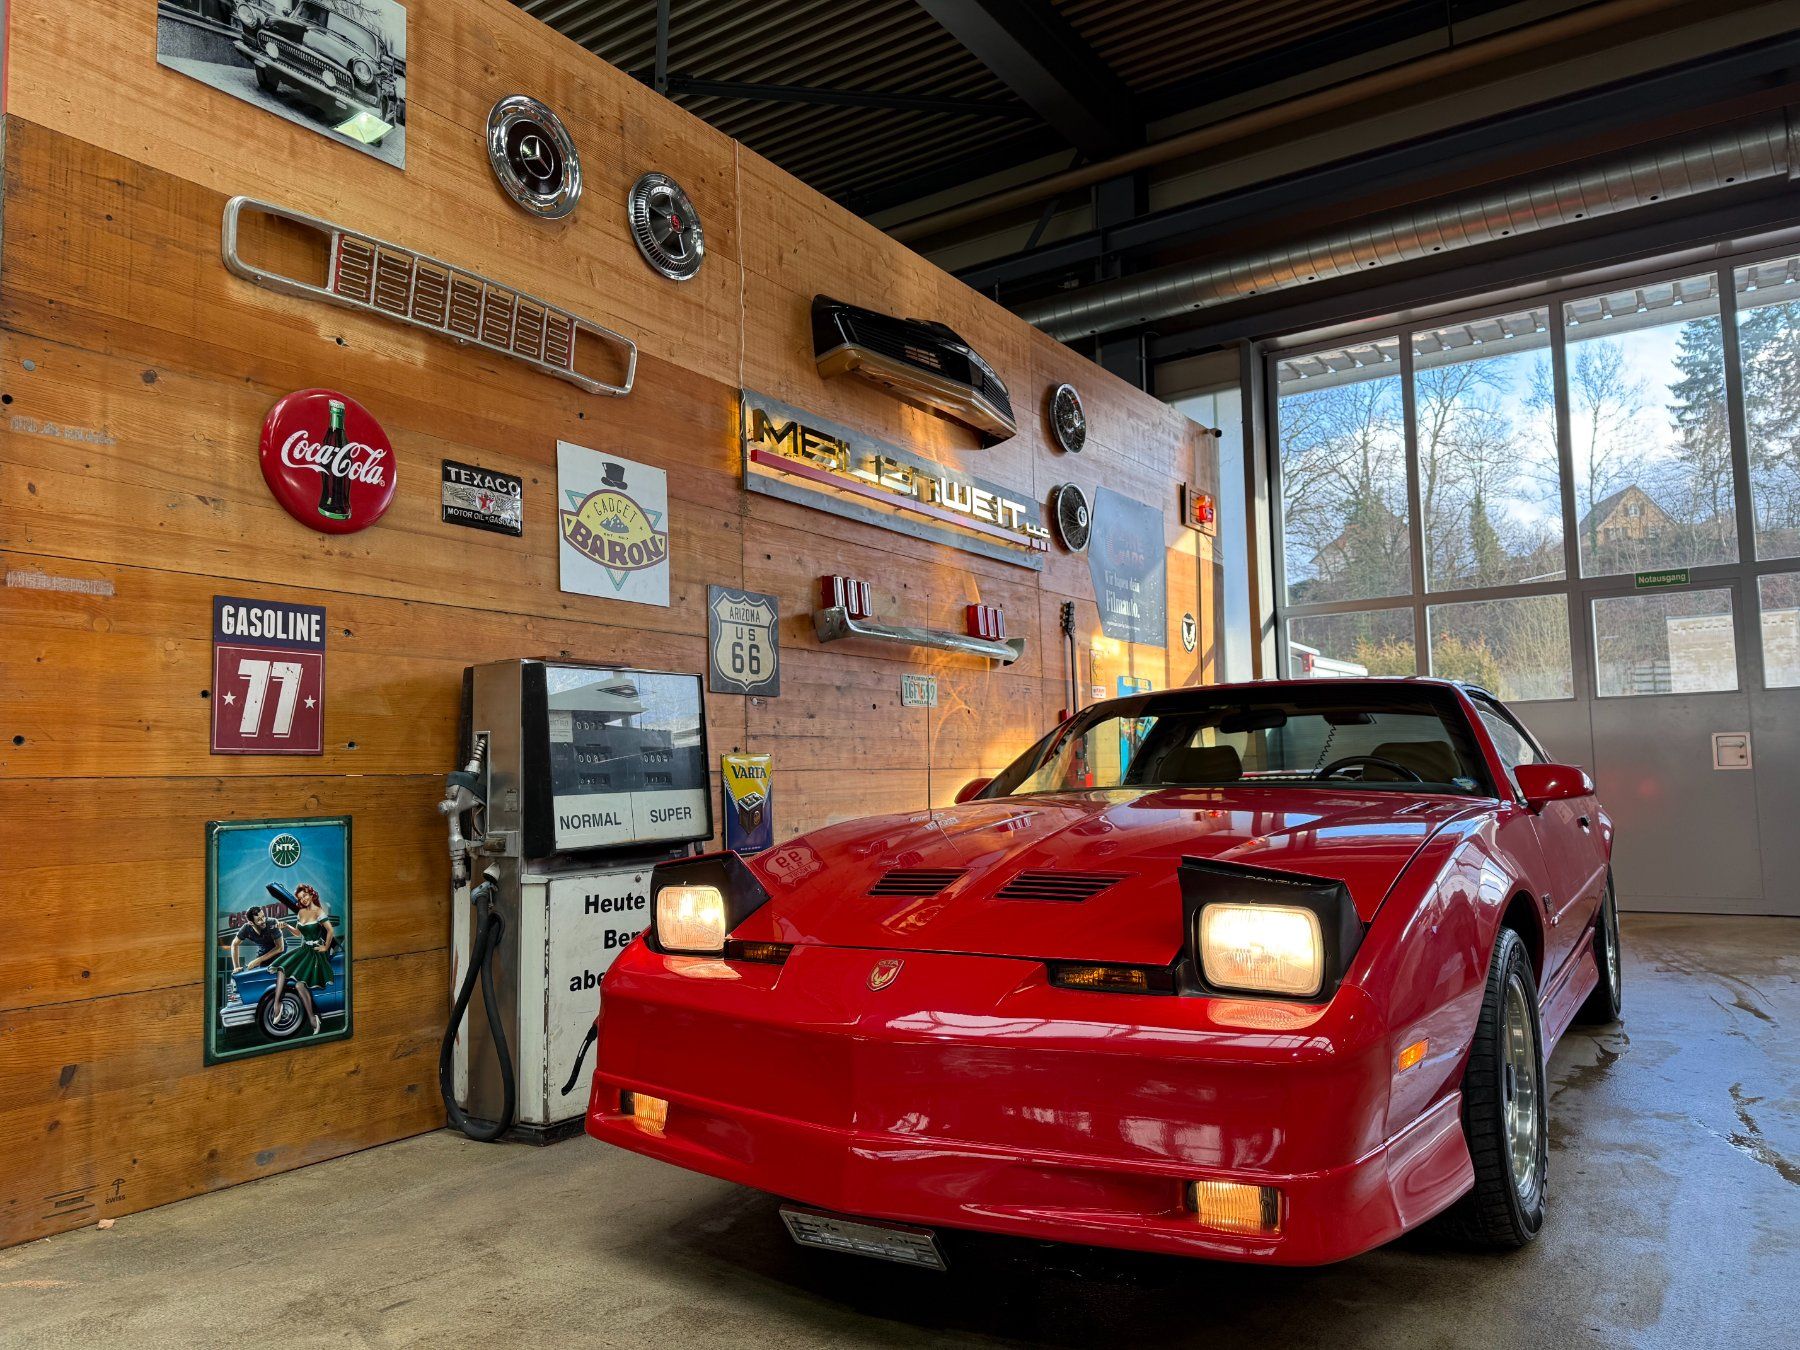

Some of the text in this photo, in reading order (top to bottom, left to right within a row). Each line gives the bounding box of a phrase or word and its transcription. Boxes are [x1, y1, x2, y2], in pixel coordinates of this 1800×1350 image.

[281, 430, 387, 485] Coca-Cola
[445, 466, 520, 497] TEXACO
[447, 507, 472, 518] MOTOR
[474, 512, 484, 521] OIL
[593, 498, 638, 523] GADGET
[568, 518, 664, 565] BARON
[1638, 573, 1686, 583] Notausgang
[222, 605, 321, 642] GASOLINE
[729, 606, 760, 623] ARIZONA
[732, 642, 760, 675] 66
[731, 765, 767, 779] VARTA
[560, 806, 692, 830] NORMAL SUPER
[276, 843, 295, 852] NTK
[585, 894, 646, 914] Heute
[105, 1194, 126, 1205] SWISS
